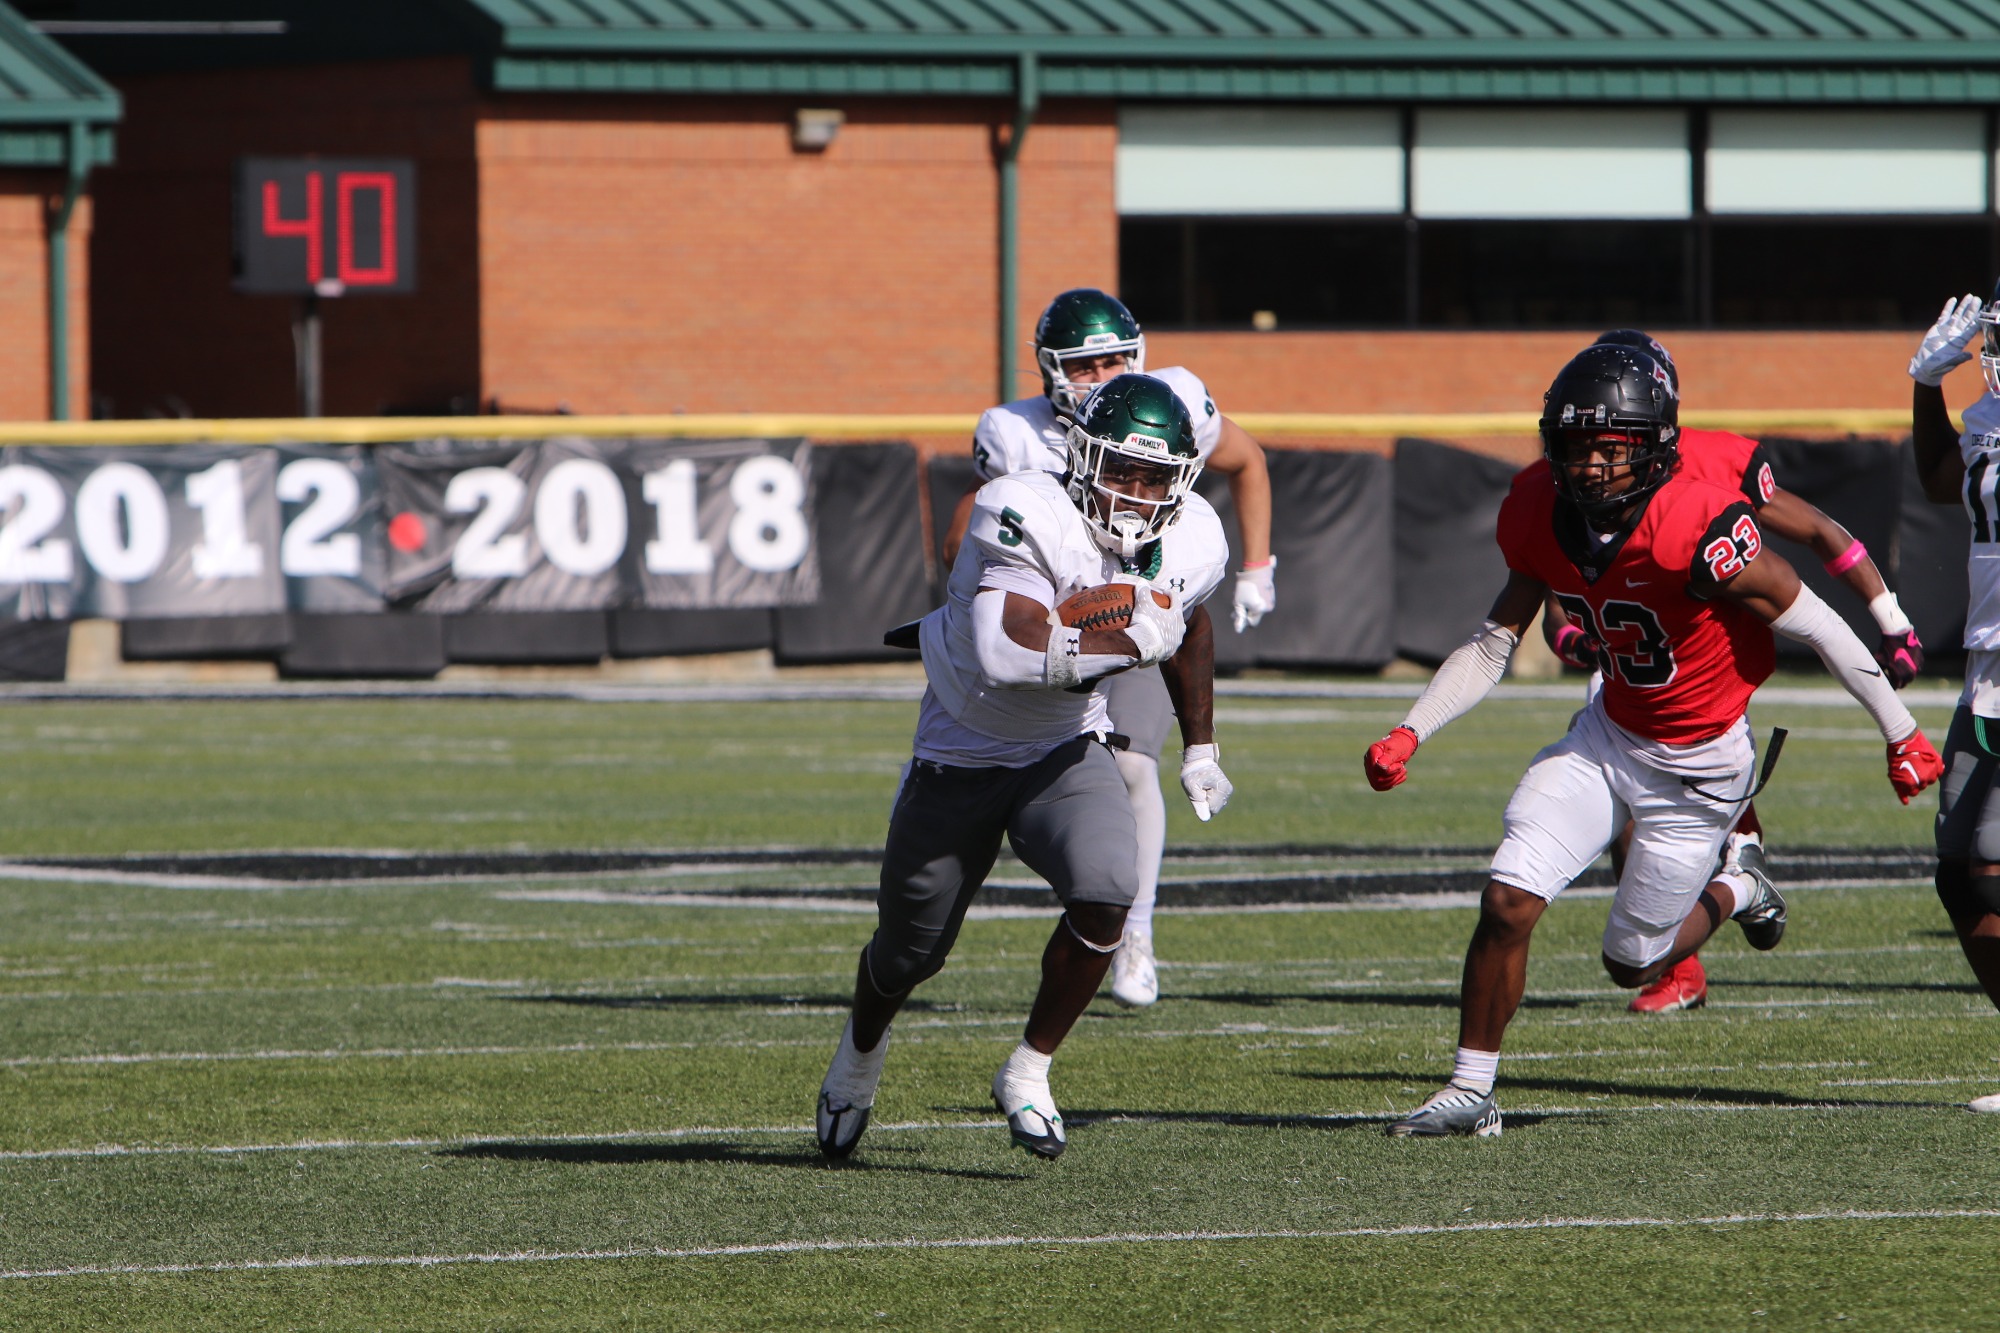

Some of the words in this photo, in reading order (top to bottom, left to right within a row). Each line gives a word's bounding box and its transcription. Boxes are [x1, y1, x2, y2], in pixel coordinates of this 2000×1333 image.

[262, 170, 397, 285] 40
[1138, 438, 1162, 450] FAMILY
[0, 457, 362, 583] 2012
[444, 455, 809, 579] 2018
[997, 505, 1026, 548] 5
[1703, 514, 1761, 582] 23
